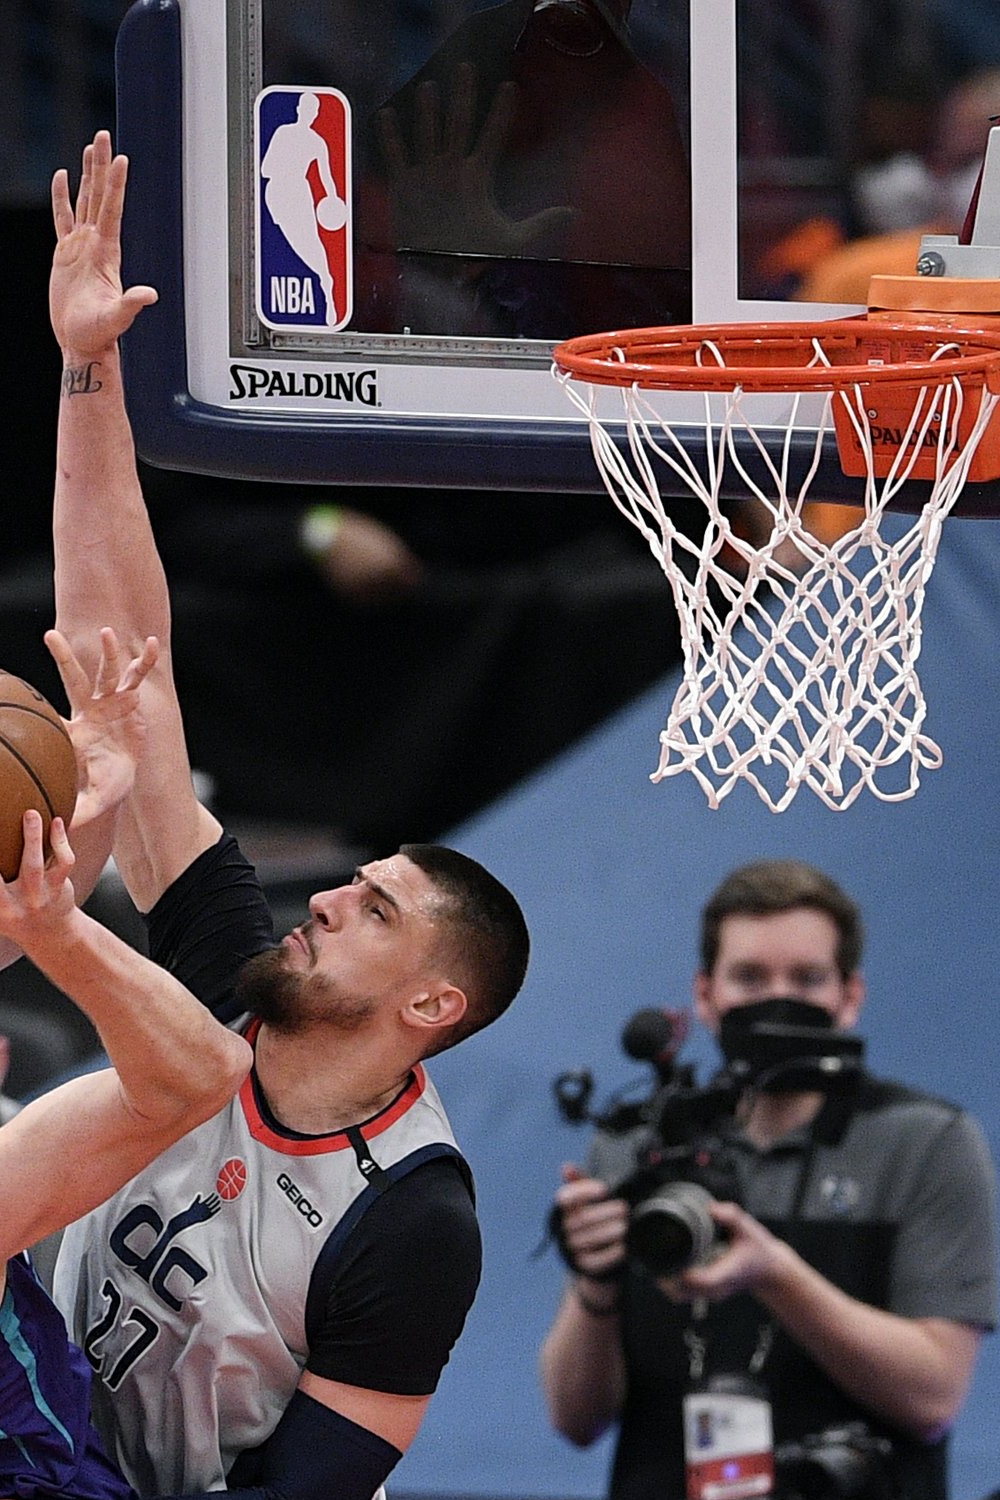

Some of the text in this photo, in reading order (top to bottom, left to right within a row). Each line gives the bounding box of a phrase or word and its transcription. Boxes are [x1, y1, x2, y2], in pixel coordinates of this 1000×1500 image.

[270, 276, 315, 314] NBA
[229, 364, 377, 406] SPALDING
[276, 1173, 323, 1228] GEICO
[84, 1277, 160, 1392] 27
